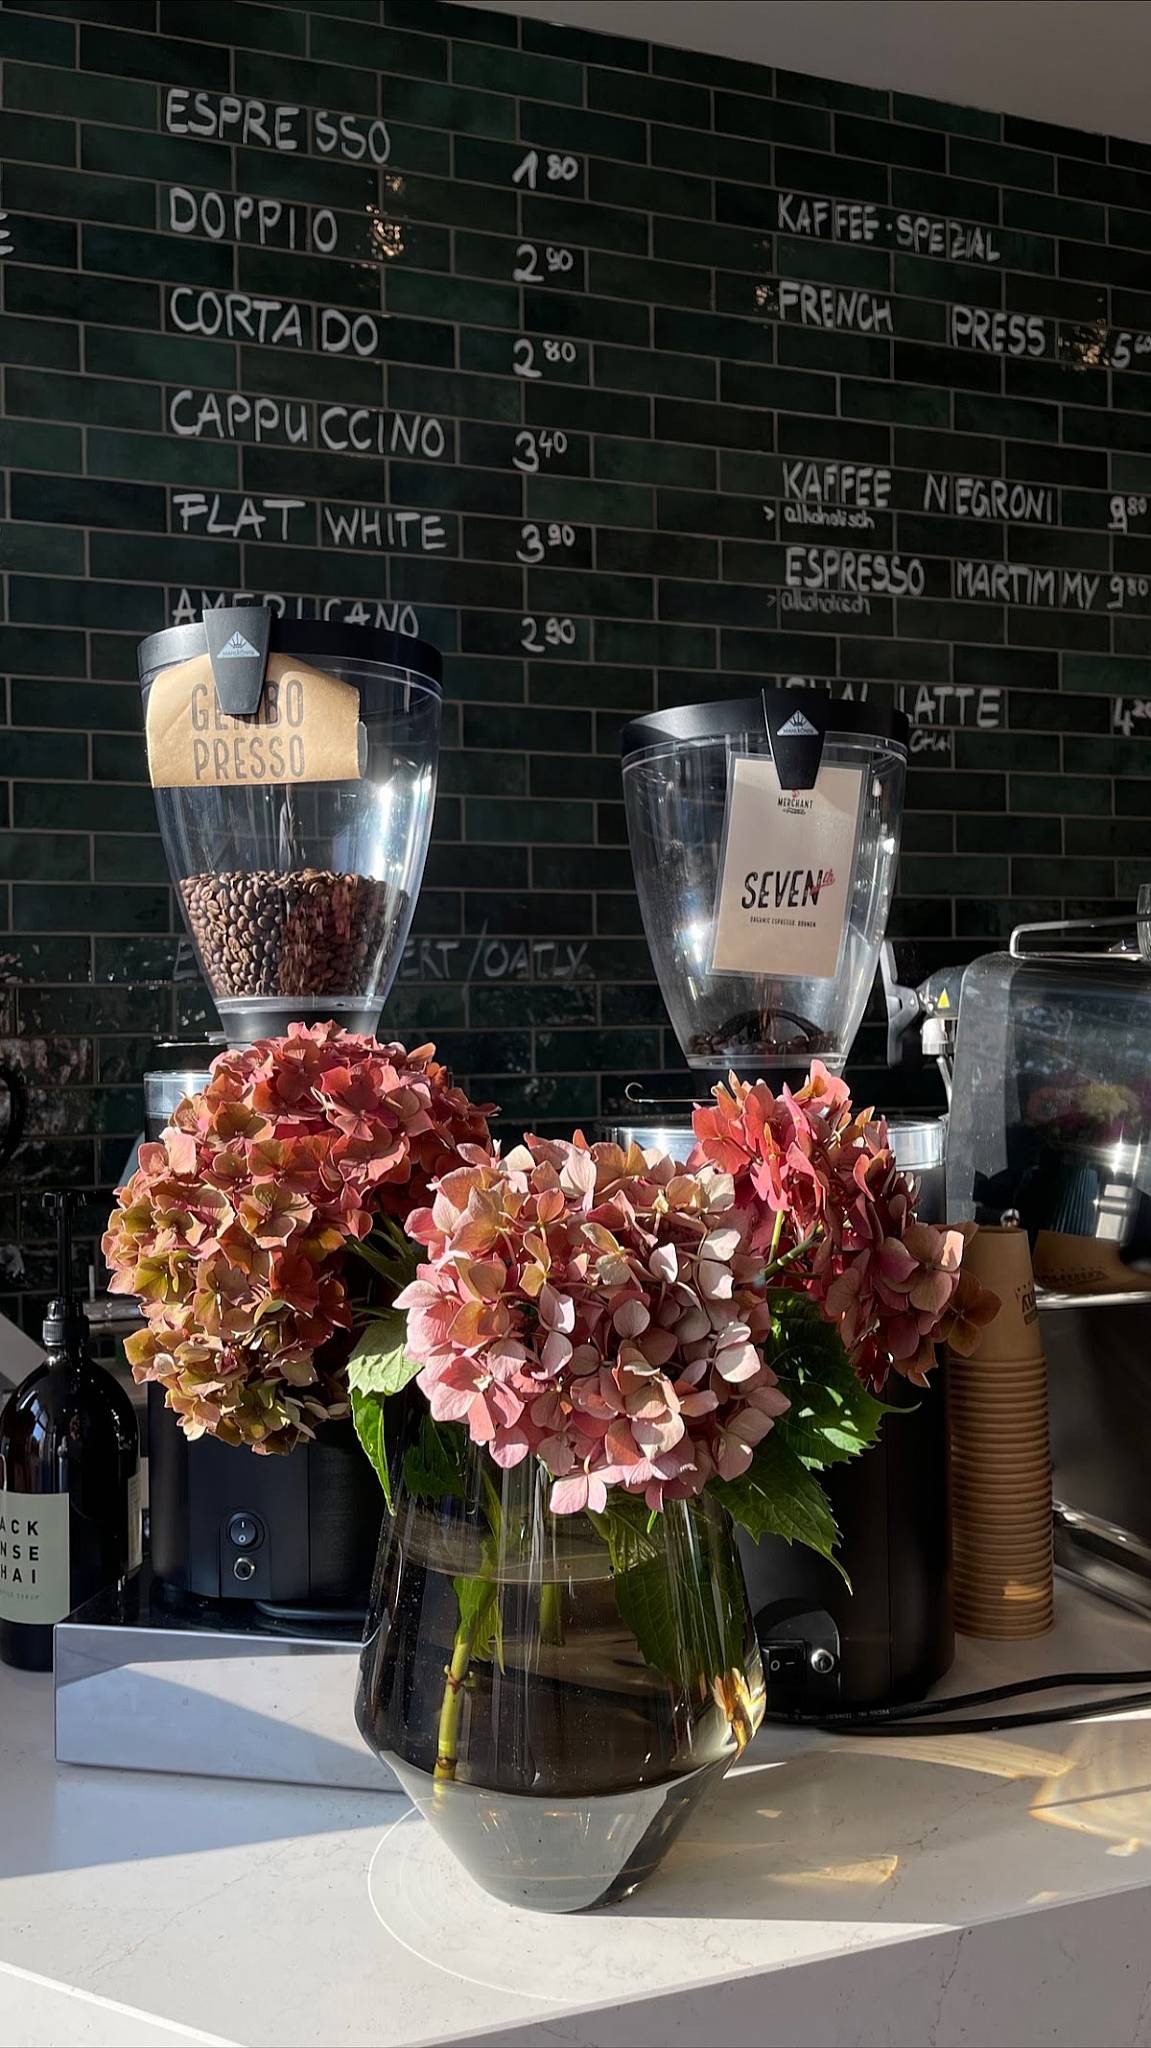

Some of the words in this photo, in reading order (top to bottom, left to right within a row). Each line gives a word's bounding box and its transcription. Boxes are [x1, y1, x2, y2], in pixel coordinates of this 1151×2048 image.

[166, 88, 391, 165] ESPRESSO
[168, 187, 338, 253] DOPPIO
[170, 287, 378, 356] CORTADO
[778, 281, 894, 332] FRENCH
[951, 305, 1046, 356] PRESS
[169, 389, 445, 458] CAPPUCCINO
[173, 493, 305, 540] FLAT
[323, 507, 448, 550] WHITE
[782, 461, 892, 508] KAFFEE
[924, 473, 1052, 523] NEGRONI
[785, 547, 925, 596] ESPRESSO
[193, 735, 305, 780] PRESSO
[777, 797, 814, 809] MERCHANT
